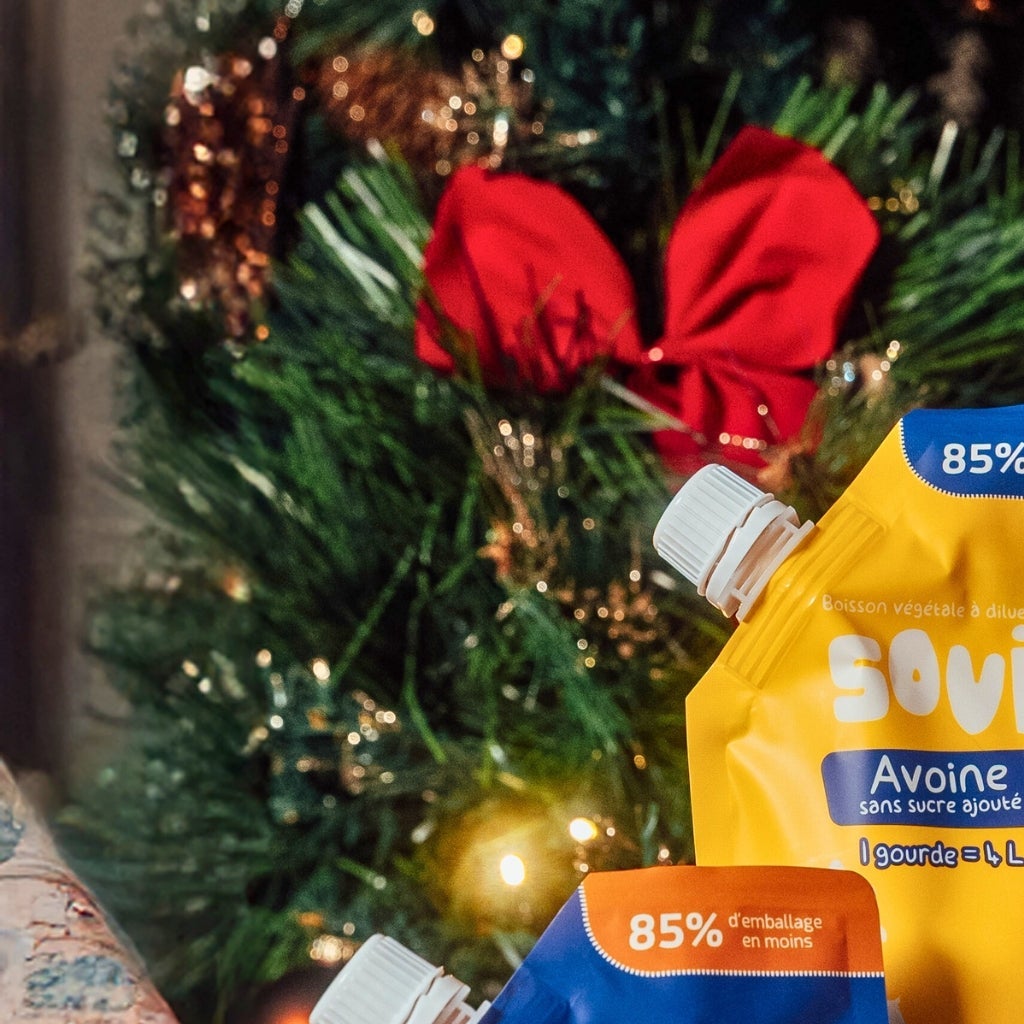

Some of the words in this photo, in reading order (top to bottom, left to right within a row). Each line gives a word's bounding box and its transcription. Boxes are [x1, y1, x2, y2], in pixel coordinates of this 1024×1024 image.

[822, 594, 887, 614] Boisson
[893, 600, 965, 618] végétale
[971, 601, 981, 618] à
[870, 754, 1008, 795] Avoine
[859, 799, 902, 815] sans
[908, 799, 956, 813] sucre
[962, 792, 1022, 817] ajouté
[875, 843, 957, 867] gourde
[986, 843, 1000, 865] 4
[1009, 843, 1024, 865] L
[628, 911, 724, 951] 85%
[728, 912, 823, 933] d'emballage
[742, 935, 761, 949] en
[764, 933, 814, 949] moins
